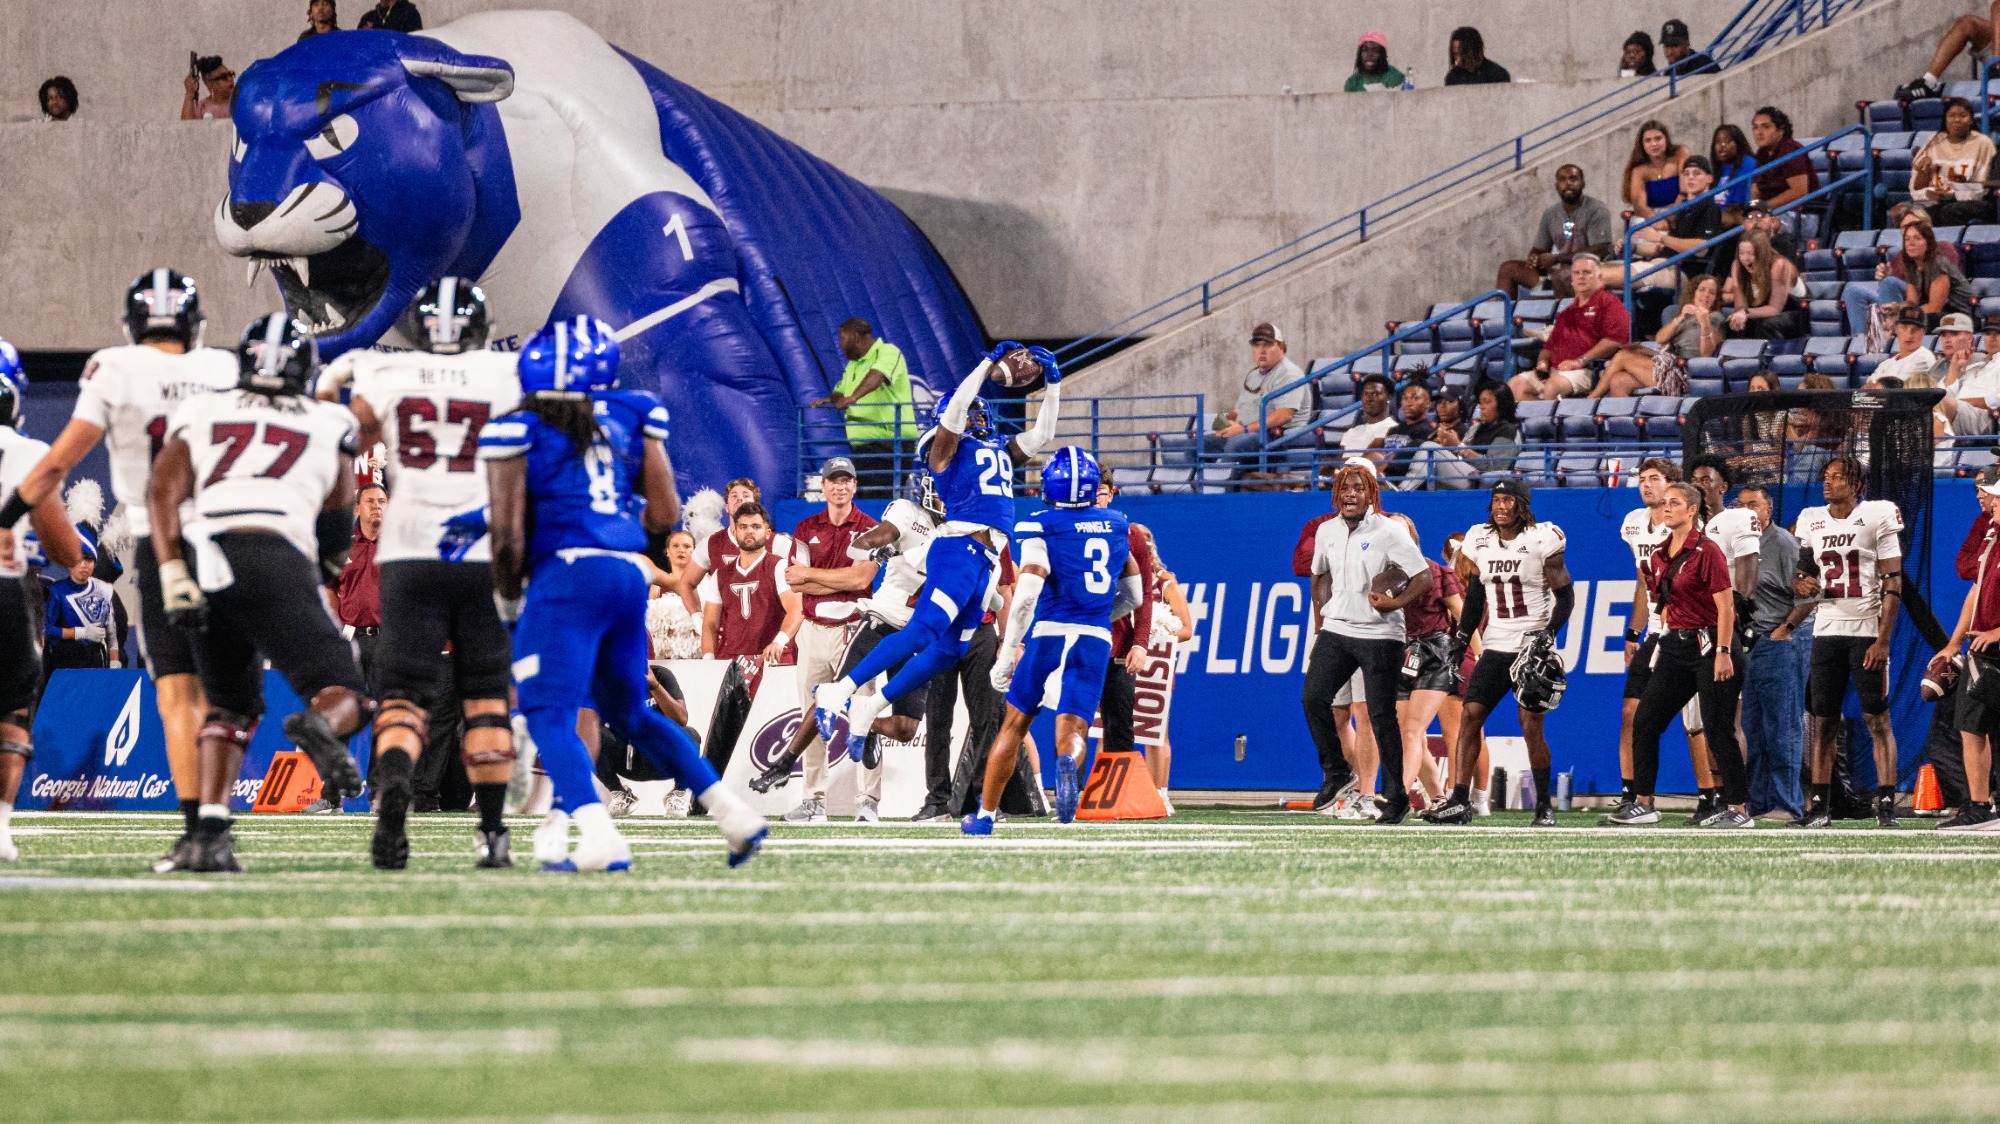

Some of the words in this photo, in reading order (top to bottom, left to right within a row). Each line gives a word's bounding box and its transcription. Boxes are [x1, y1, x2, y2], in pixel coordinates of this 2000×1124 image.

[662, 213, 694, 261] 1
[204, 421, 310, 489] 77
[397, 397, 491, 472] 67
[584, 443, 619, 515] 8
[975, 448, 1014, 498] 29
[1074, 521, 1112, 533] PRINGLE
[1638, 544, 1661, 557] TRO
[1822, 533, 1856, 549] TROY
[1083, 538, 1112, 594] 3
[1488, 560, 1522, 574] TROY
[1819, 550, 1863, 599] 21
[730, 580, 760, 620] T
[1491, 575, 1529, 619] 11
[1133, 641, 1173, 740] NOISE
[31, 773, 89, 804] Georgia
[87, 773, 147, 799] Natural
[142, 773, 171, 799] Gas
[258, 757, 299, 806] 10
[1080, 757, 1131, 810] 20
